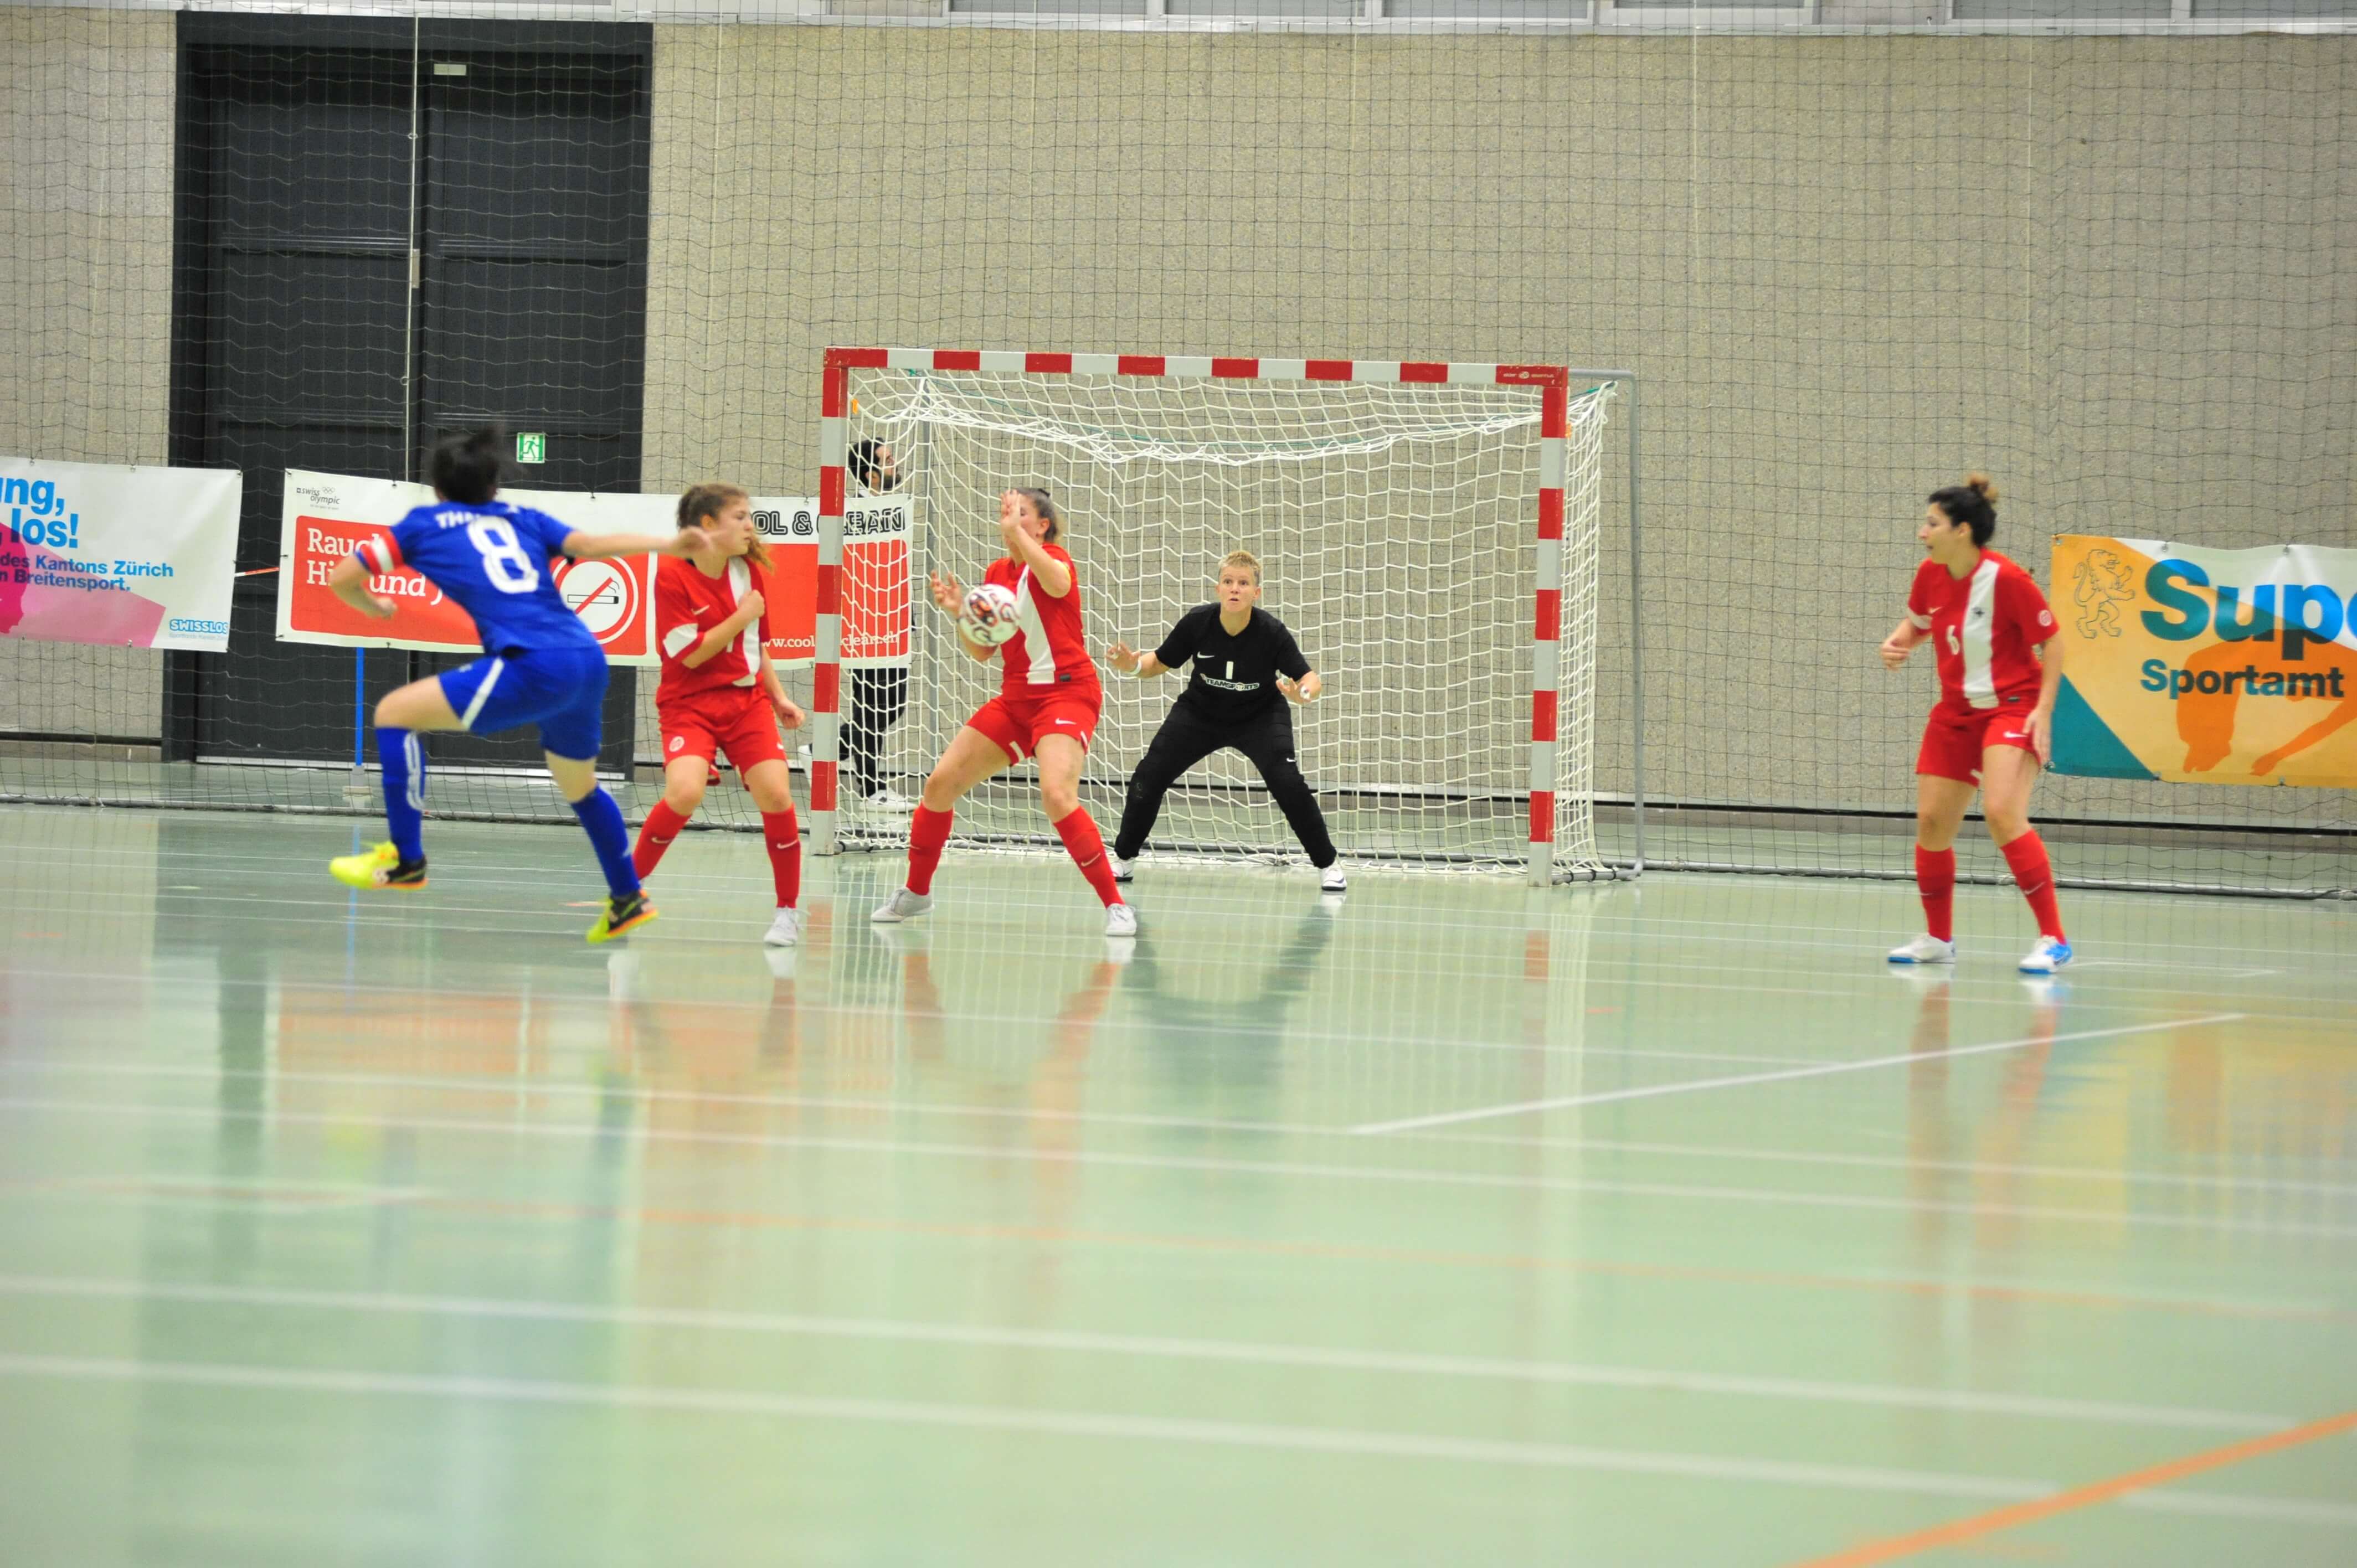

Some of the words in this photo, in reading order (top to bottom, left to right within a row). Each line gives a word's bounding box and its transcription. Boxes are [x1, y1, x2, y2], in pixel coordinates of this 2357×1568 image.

[0, 477, 65, 517] ng,
[301, 487, 320, 496] swiss
[310, 495, 341, 505] olympic
[11, 508, 79, 549] los!
[750, 510, 788, 535] OL
[792, 511, 813, 535] &
[817, 507, 905, 535] EAN
[307, 528, 381, 557] Rauc
[466, 515, 540, 594] 8
[0, 551, 30, 568] des
[35, 555, 107, 574] Kantons
[114, 560, 174, 577] Zürich
[306, 560, 333, 586] Hi
[369, 573, 426, 597] und
[14, 569, 131, 591] Breitensport.
[2140, 559, 2357, 661] Sup
[169, 619, 228, 634] SWISSLOS
[2140, 658, 2345, 700] Sportamt
